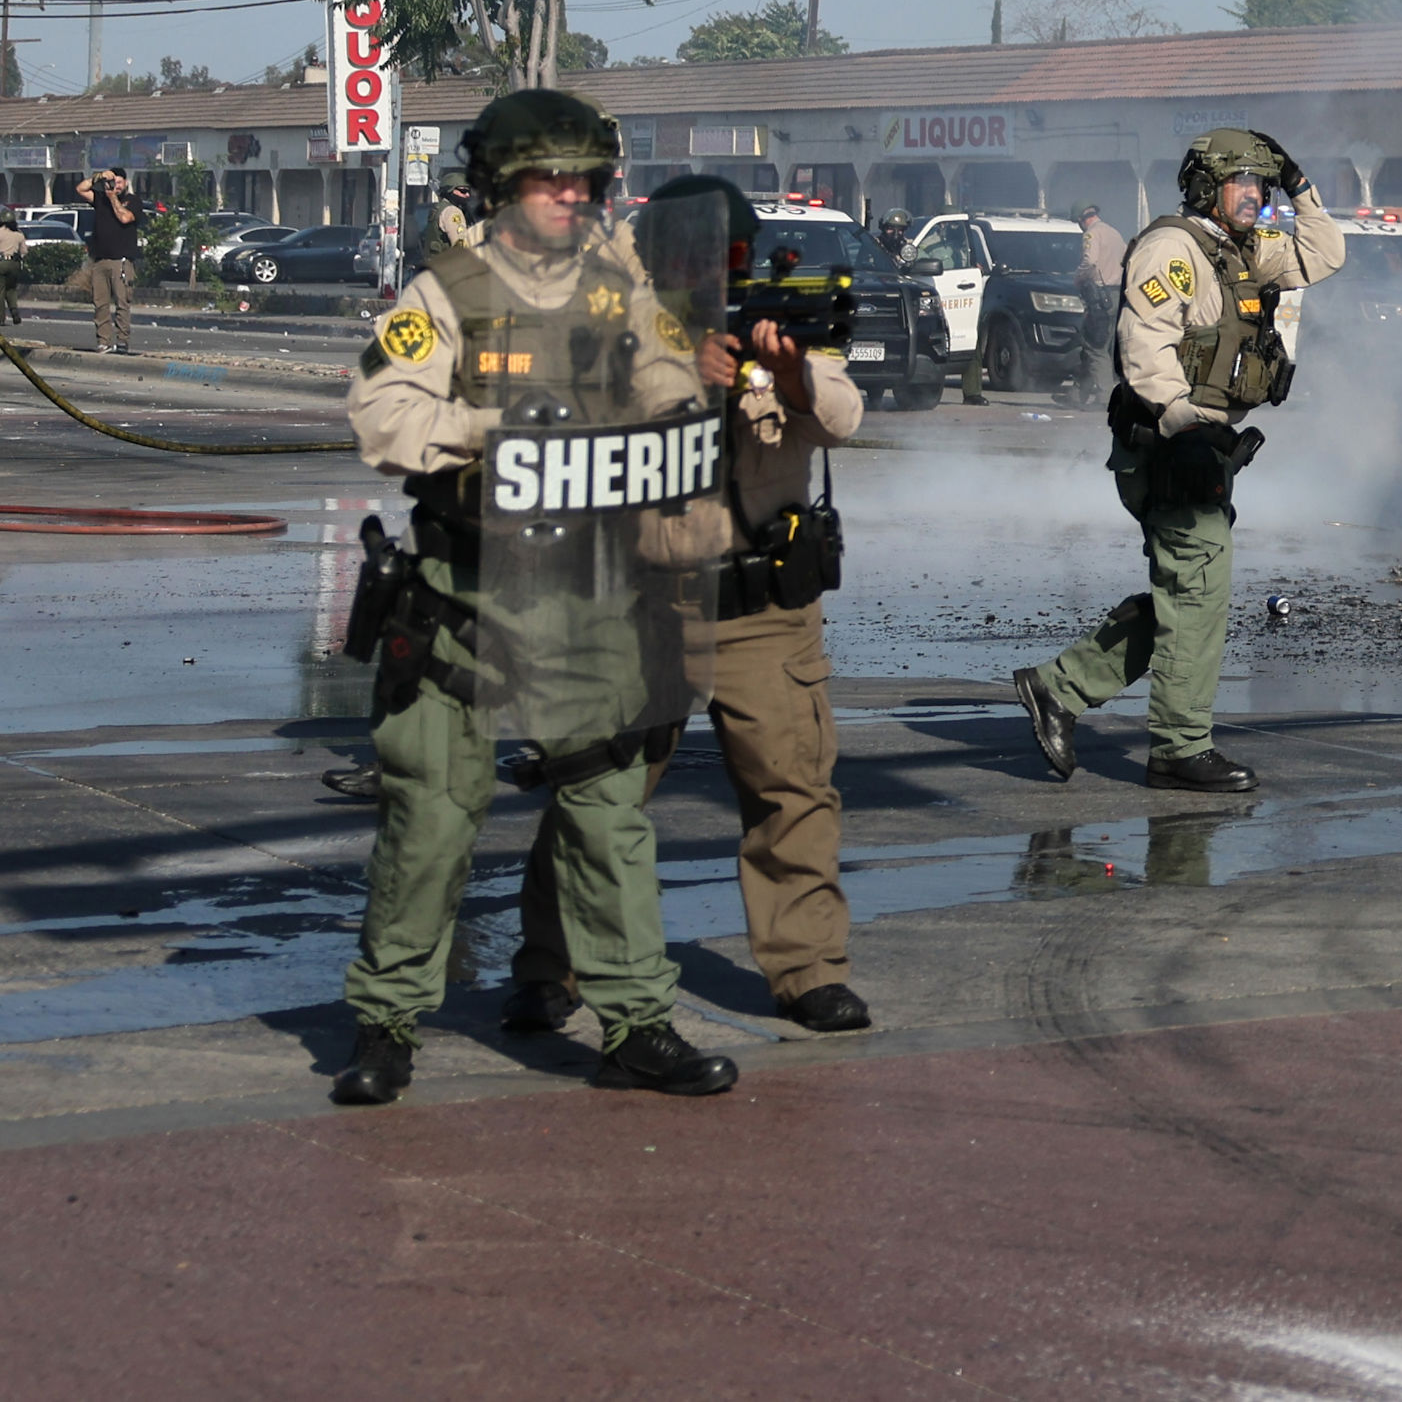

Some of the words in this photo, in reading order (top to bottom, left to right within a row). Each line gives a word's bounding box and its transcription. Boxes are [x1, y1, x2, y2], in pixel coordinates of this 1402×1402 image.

[904, 115, 1006, 149] LIQUOR
[940, 298, 974, 310] HERIFF
[495, 417, 722, 511] SHERIFF
